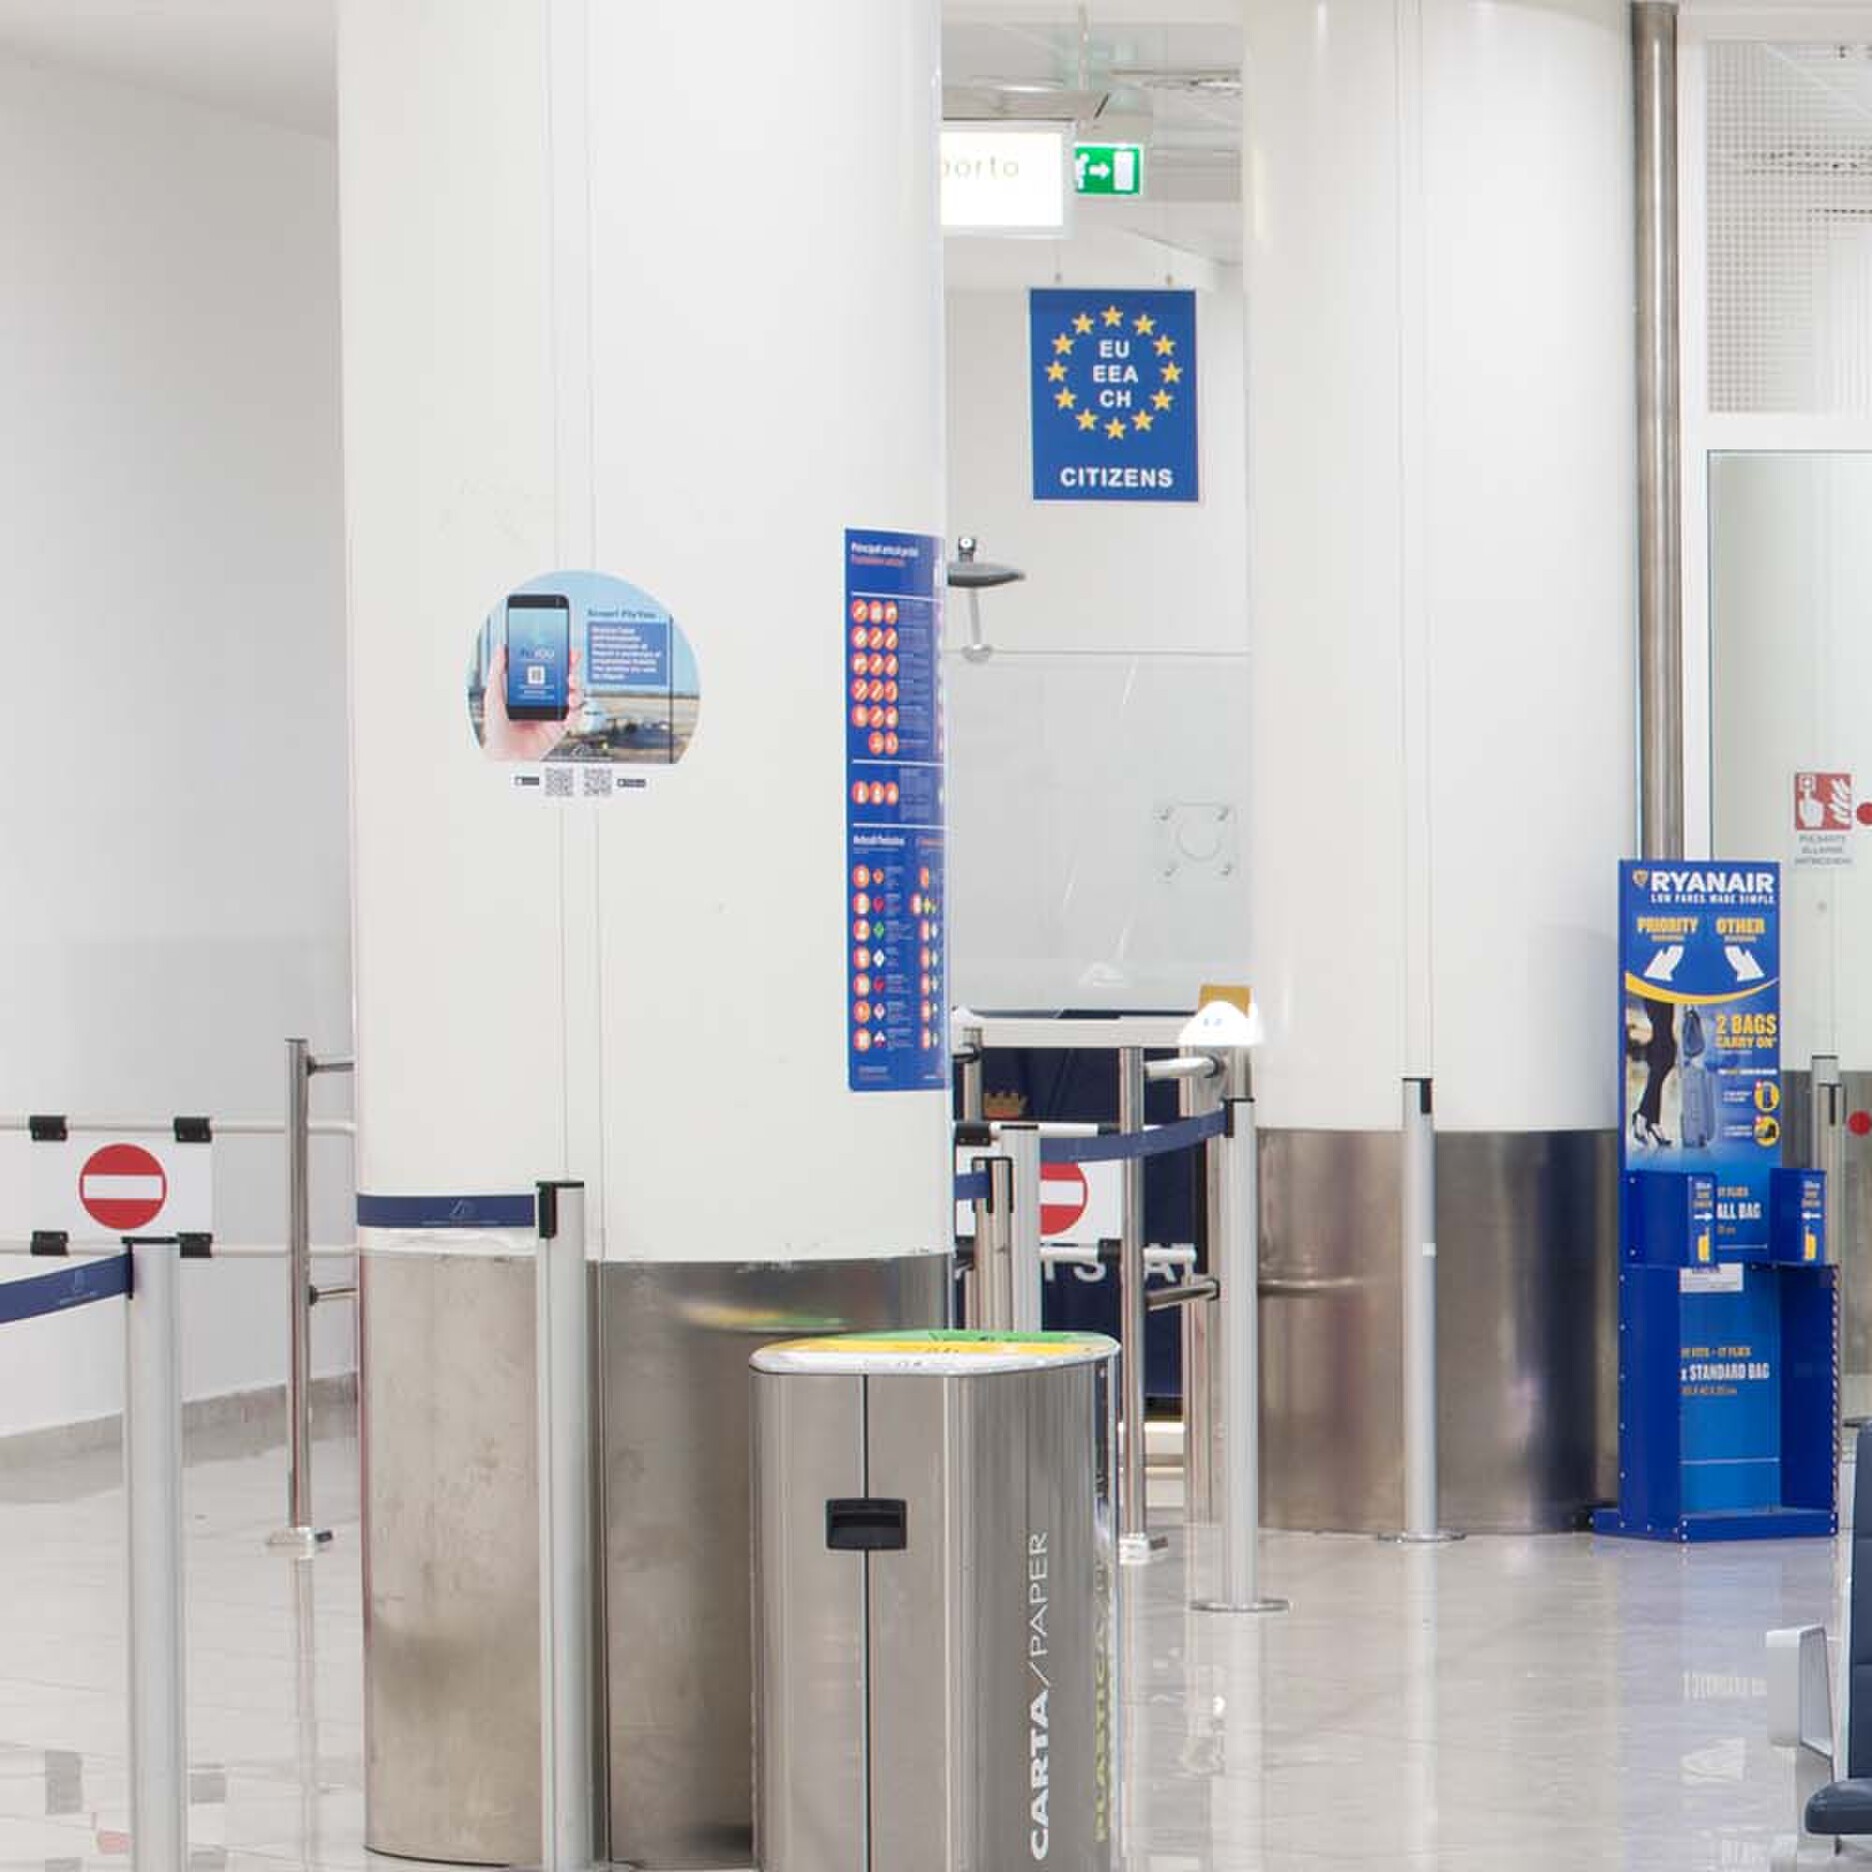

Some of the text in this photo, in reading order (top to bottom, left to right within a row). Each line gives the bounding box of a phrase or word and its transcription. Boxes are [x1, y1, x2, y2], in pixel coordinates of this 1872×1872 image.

[1098, 339, 1130, 359] EU
[1092, 364, 1139, 383] EEA
[1099, 389, 1131, 408] CH
[1059, 467, 1174, 488] CITIZENS
[1650, 870, 1775, 894] RYANAIR
[1715, 917, 1765, 936] OTHER
[1716, 1013, 1777, 1035] 2 BAGS
[1689, 1362, 1746, 1382] STANDARD
